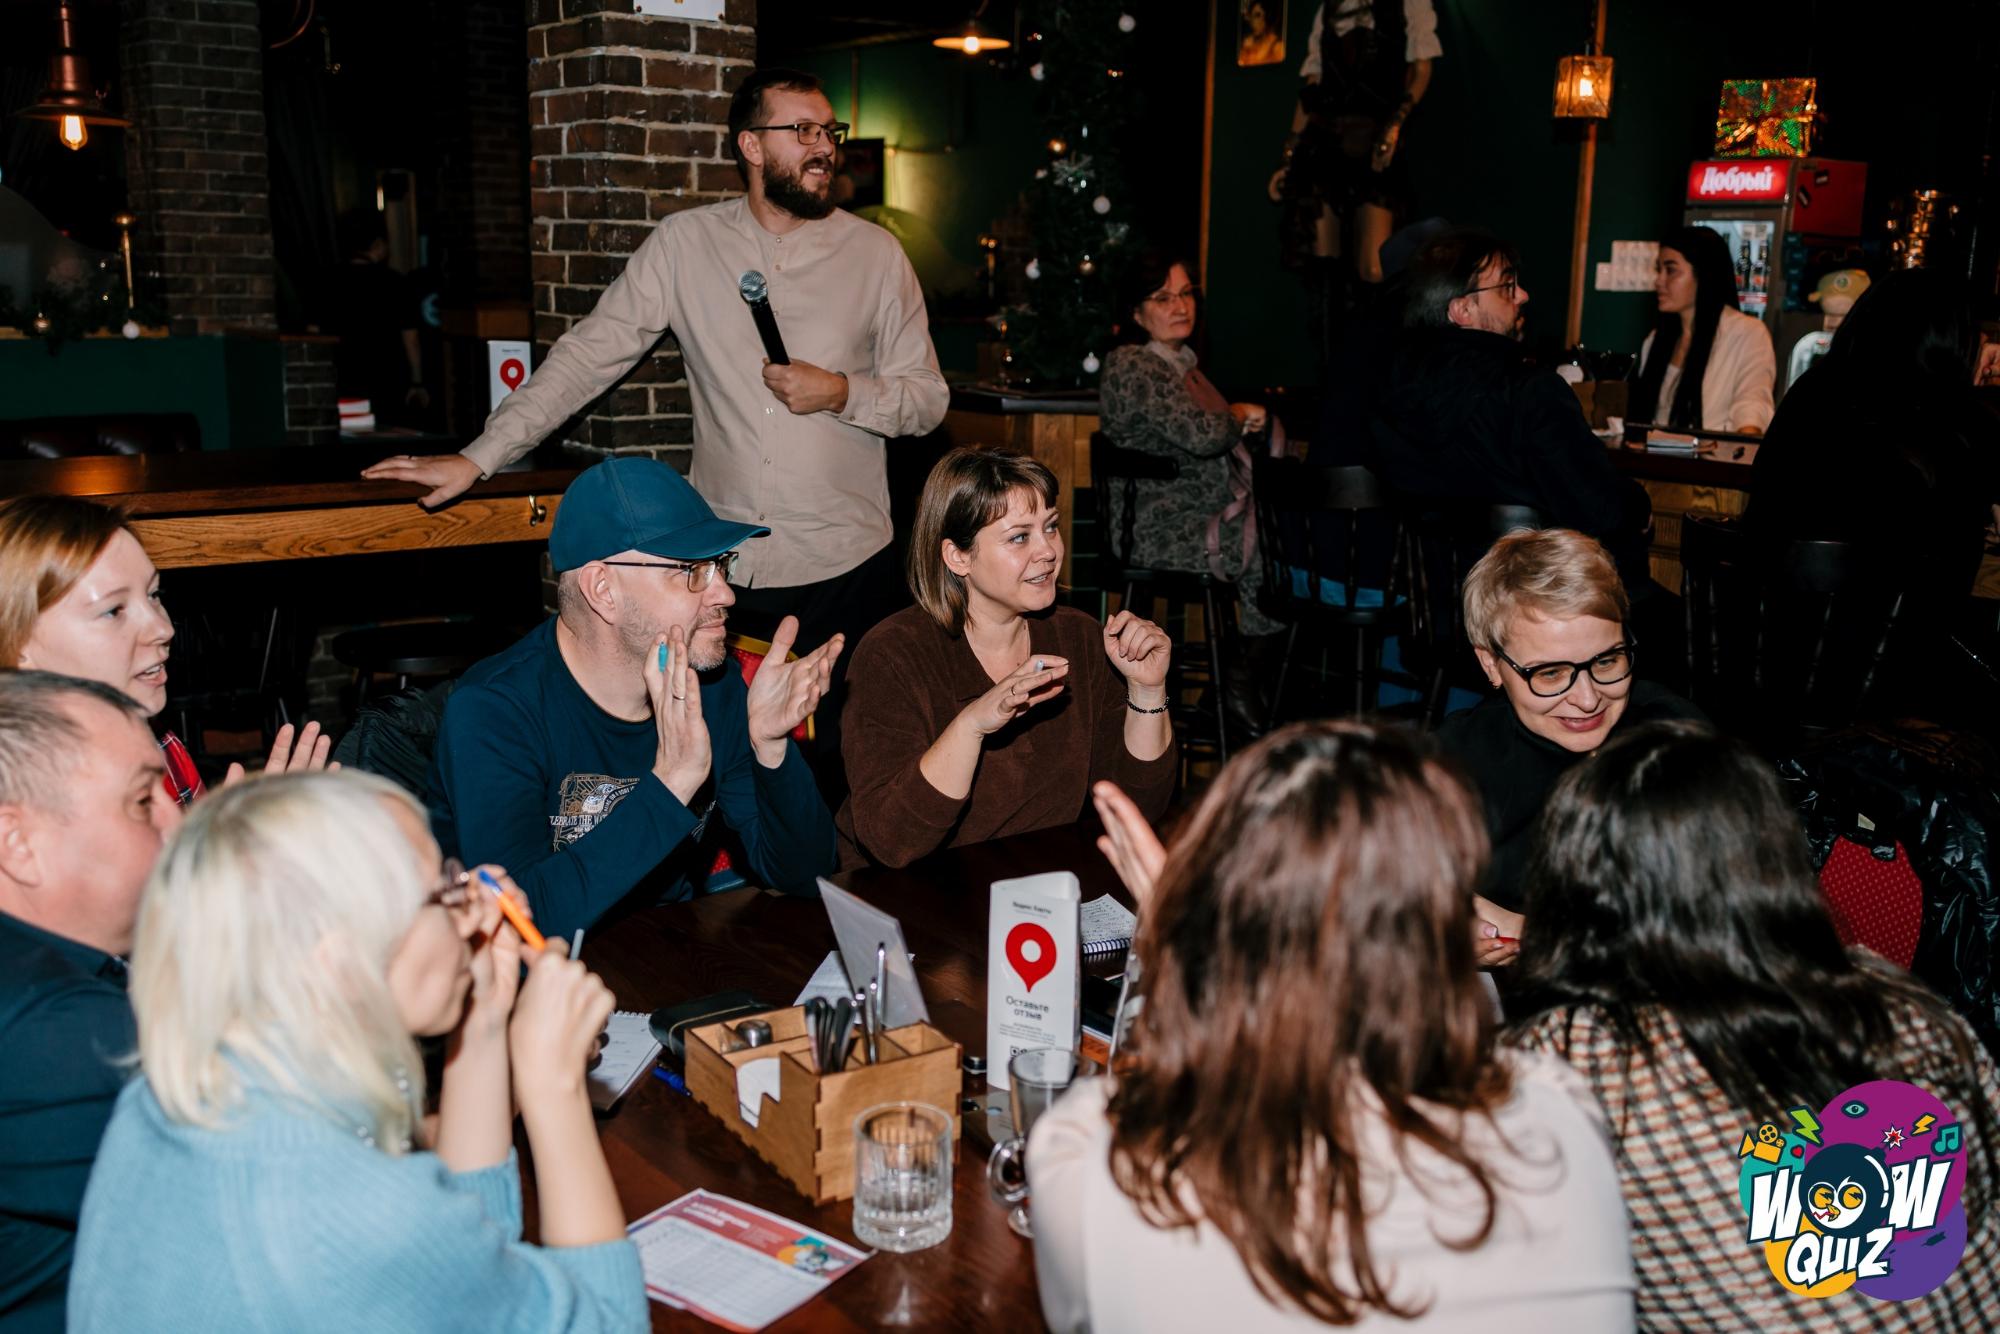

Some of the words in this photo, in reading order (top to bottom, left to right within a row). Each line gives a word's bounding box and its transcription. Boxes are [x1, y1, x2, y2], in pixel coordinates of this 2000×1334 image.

[1700, 166, 1774, 195] Добрый
[1006, 995, 1049, 1013] Оставьте
[1014, 1009, 1042, 1021] отзыв
